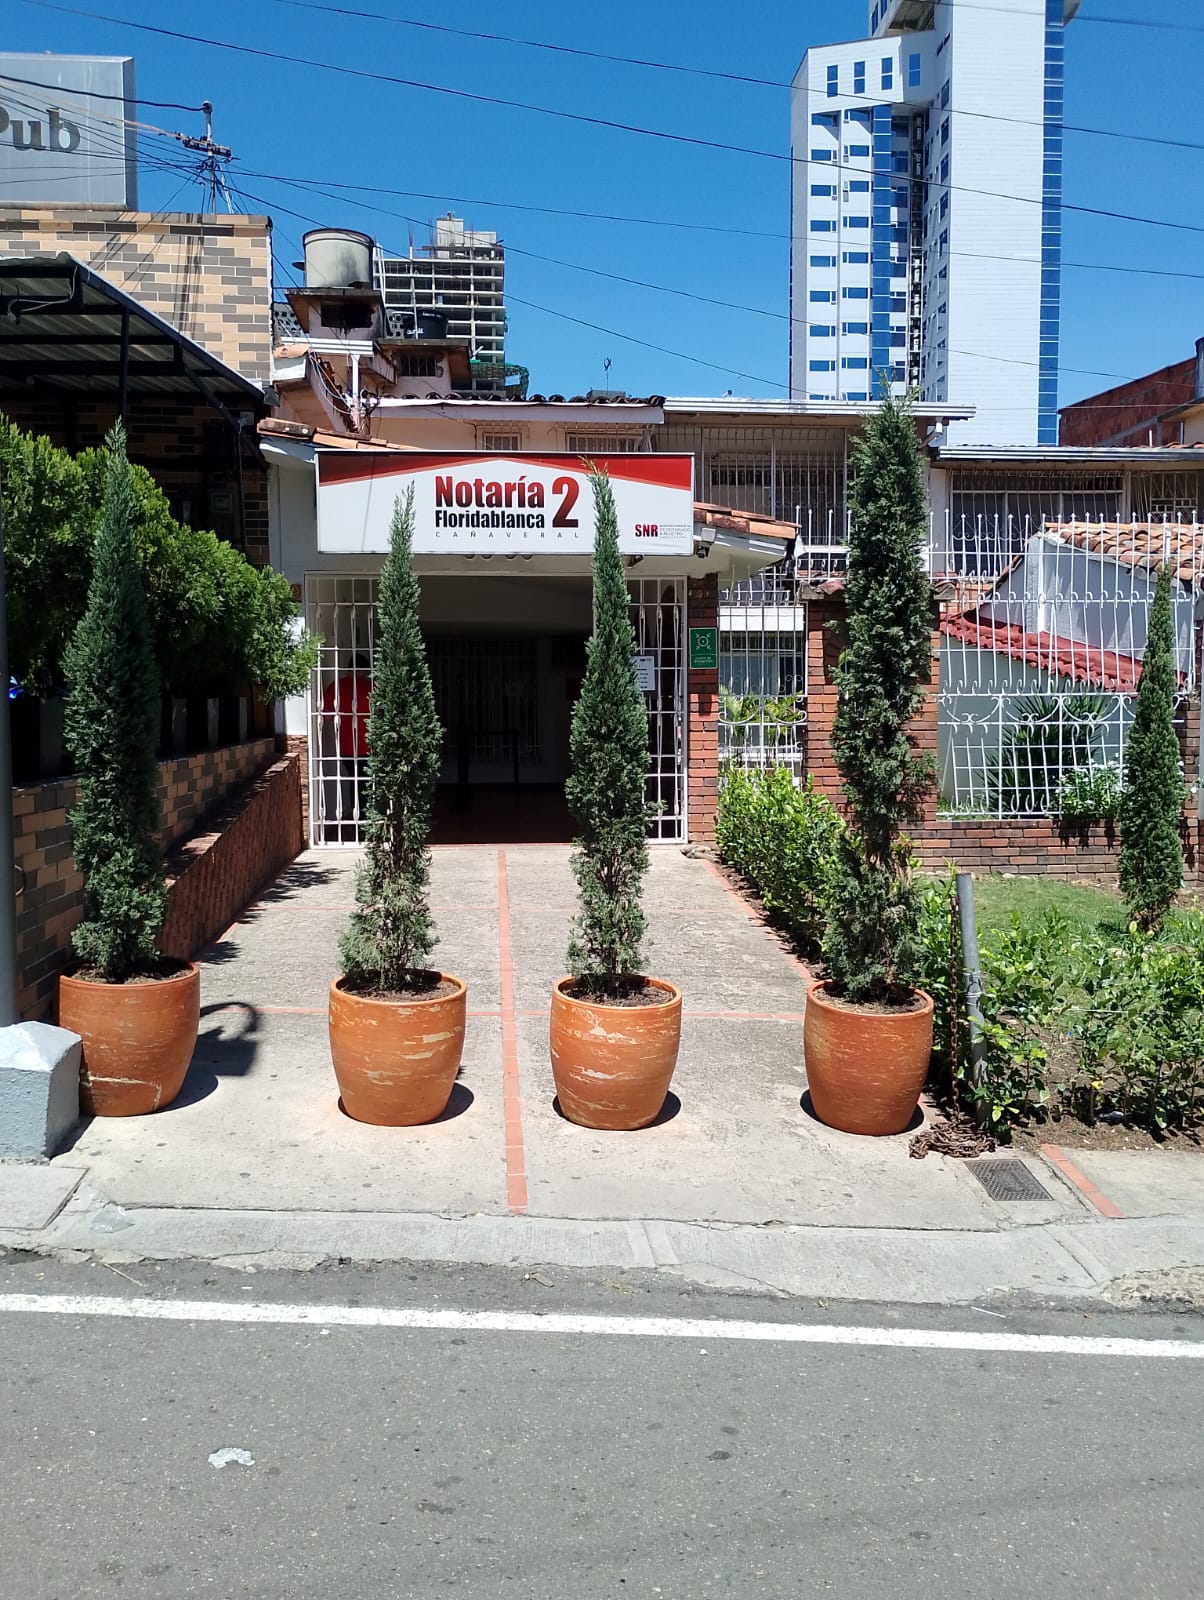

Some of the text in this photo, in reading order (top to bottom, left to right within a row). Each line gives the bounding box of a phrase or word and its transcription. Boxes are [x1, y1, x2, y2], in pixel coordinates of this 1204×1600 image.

[435, 475, 579, 528] Notaría 2
[435, 510, 545, 529] Floridablanca
[635, 524, 658, 537] SNR
